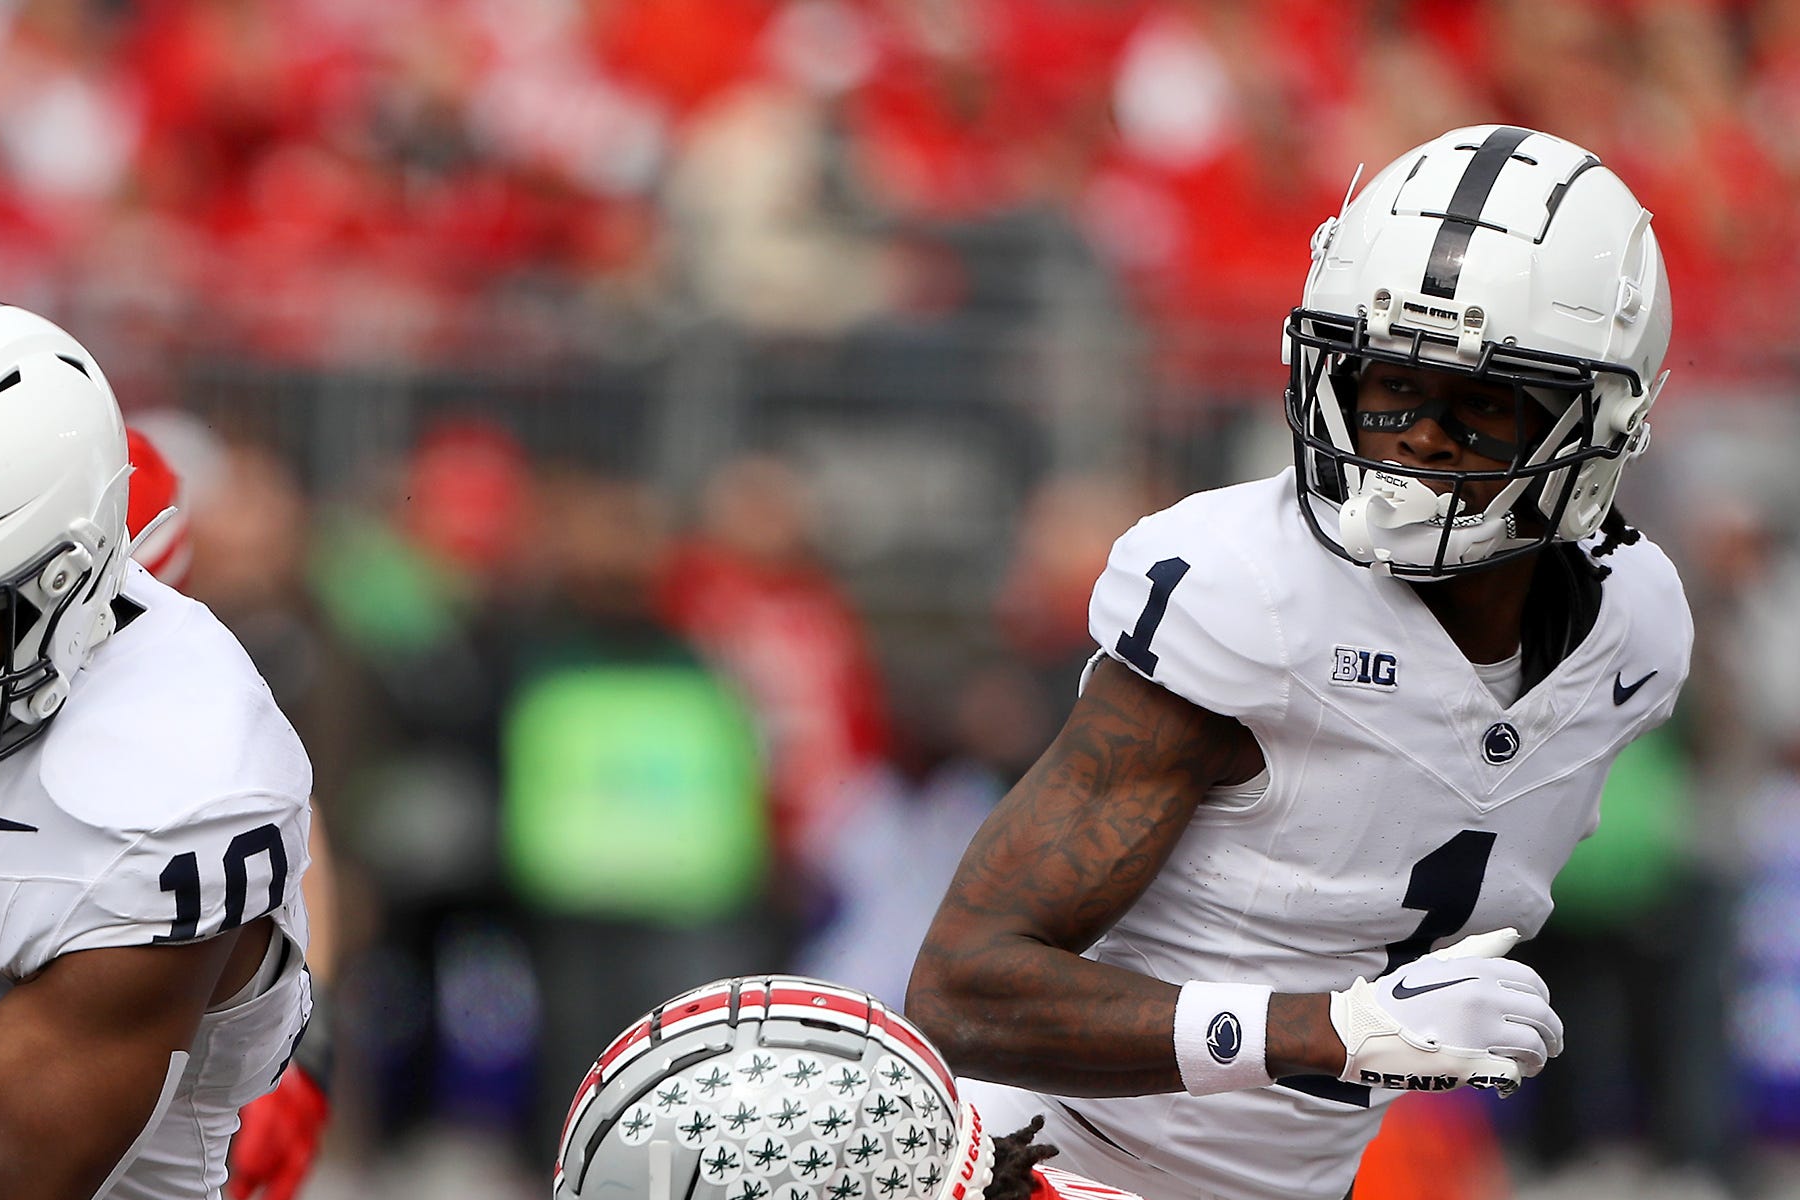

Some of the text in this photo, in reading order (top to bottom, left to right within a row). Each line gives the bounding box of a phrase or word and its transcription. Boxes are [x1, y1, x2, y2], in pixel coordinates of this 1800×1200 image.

[1375, 470, 1409, 489] SHOCK
[1114, 556, 1191, 678] 1
[152, 823, 288, 944] 10
[1360, 1069, 1459, 1091] PENN
